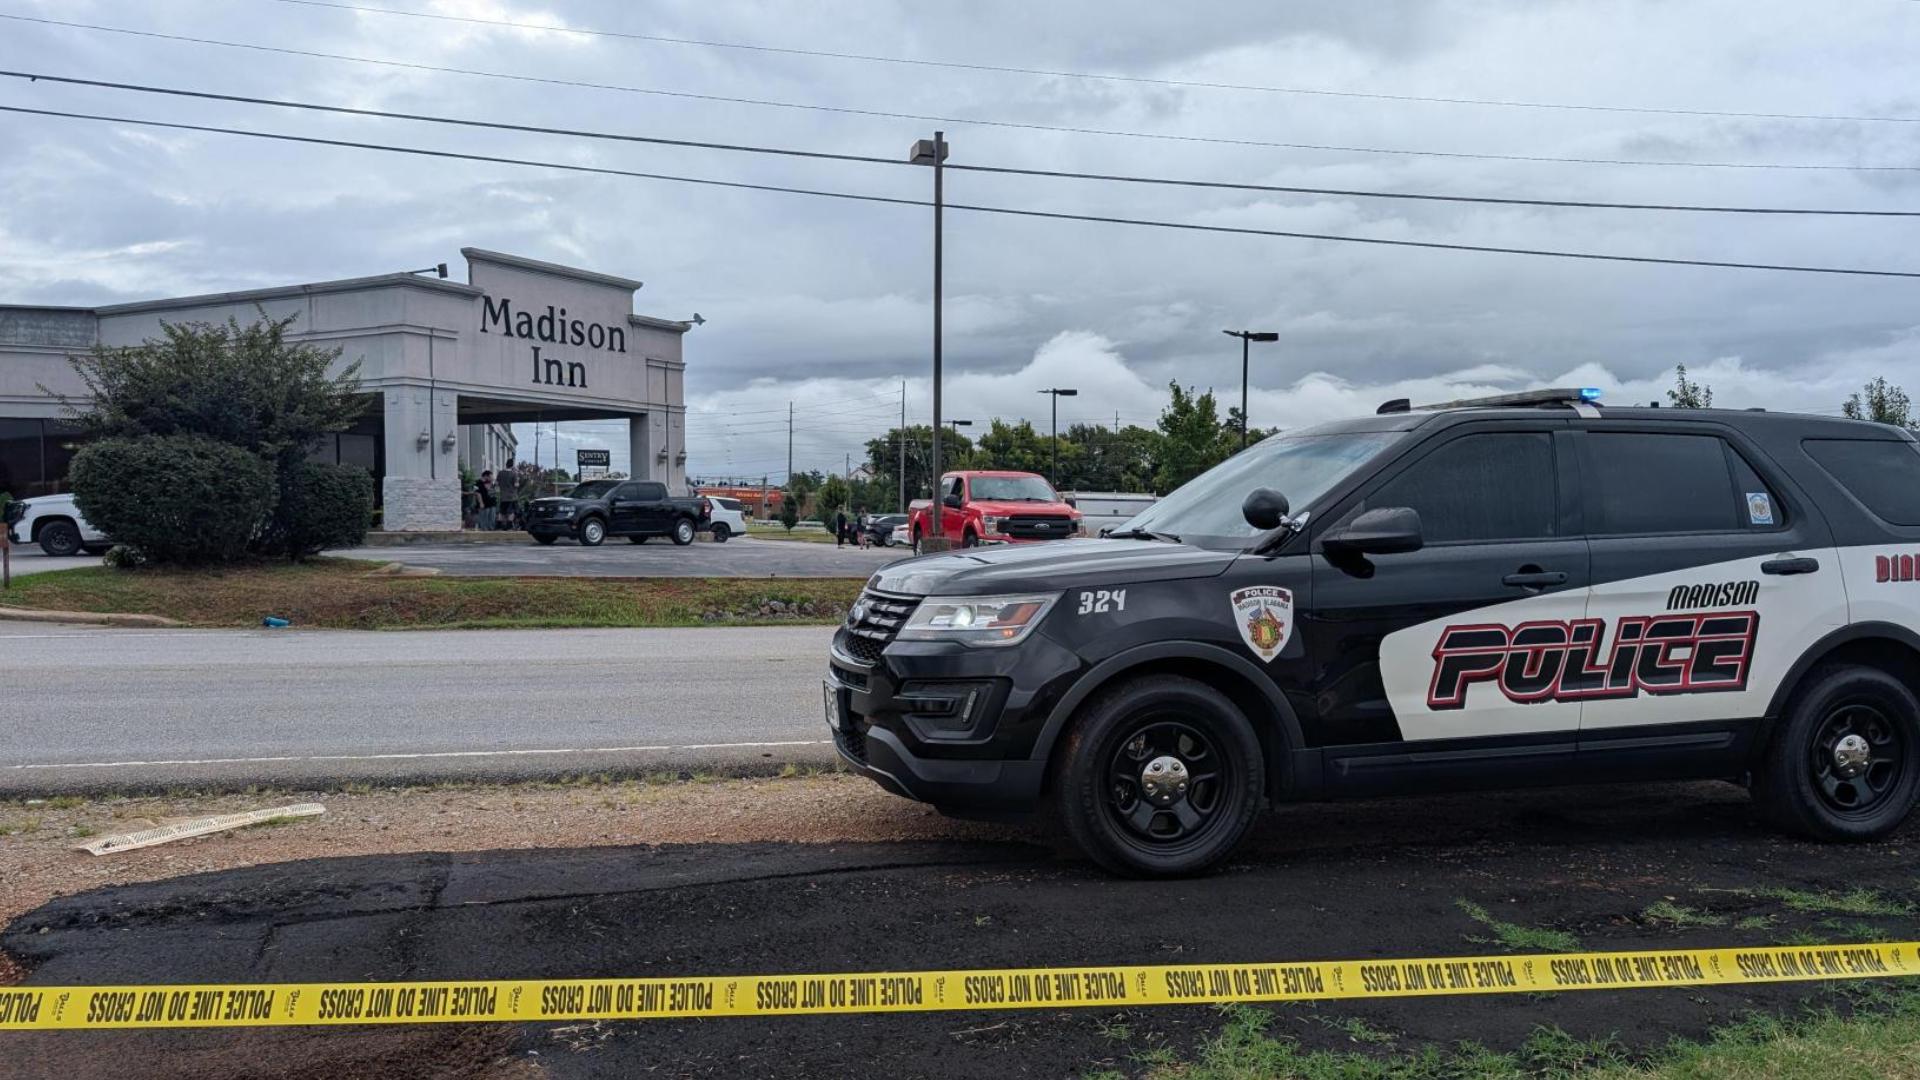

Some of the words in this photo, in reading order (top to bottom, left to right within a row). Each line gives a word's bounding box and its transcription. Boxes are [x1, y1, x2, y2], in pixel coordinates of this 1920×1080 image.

[480, 295, 627, 353] Madison
[531, 346, 588, 388] Inn
[1078, 588, 1127, 615] 324
[1244, 588, 1279, 598] POLICE
[1666, 580, 1760, 611] MADISON
[1426, 610, 1761, 711] POLICE
[1472, 961, 1517, 987] POLICE
[1550, 958, 1592, 985] CROSS
[1590, 958, 1618, 983] NOT
[1614, 957, 1637, 982] DO
[1632, 956, 1665, 981] LINE
[1659, 955, 1705, 980] POLICE
[1735, 952, 1779, 978] CROSS
[1775, 951, 1804, 977] NOT
[1798, 951, 1822, 976] DO
[1815, 950, 1849, 974] LINE
[1842, 949, 1889, 973] POLICE
[964, 975, 1005, 1004] CROSS
[1008, 975, 1032, 1003] NOT
[1034, 974, 1052, 1002] DO
[1054, 973, 1082, 1001] LINE
[1083, 972, 1126, 1000] POLICE
[1165, 970, 1206, 998] CROSS
[1208, 969, 1232, 997] NOT
[1233, 969, 1252, 996] DO
[1252, 968, 1280, 995] LINE
[1280, 966, 1324, 994] POLICE
[1360, 964, 1401, 992] CROSS
[1402, 964, 1427, 990] NOT
[1426, 963, 1446, 990] DO
[1444, 962, 1472, 989] LINE
[189, 990, 224, 1021] LINE
[224, 989, 275, 1020] POLICE
[318, 988, 365, 1019] CROSS
[365, 988, 395, 1018] NOT
[396, 988, 417, 1018] DO
[417, 987, 449, 1017] LINE
[450, 986, 498, 1016] POLICE
[541, 985, 584, 1015] CROSS
[586, 985, 613, 1014] NOT
[616, 984, 634, 1013] DO
[637, 983, 666, 1012] LINE
[669, 982, 713, 1011] POLICE
[756, 980, 798, 1010] CROSS
[801, 980, 825, 1009] NOT
[829, 979, 846, 1008] DO
[850, 978, 877, 1007] LINE
[880, 977, 923, 1006] POLICE
[0, 992, 44, 1024] POLIC
[87, 992, 136, 1023] CROSS
[135, 991, 168, 1022] NOT
[167, 991, 190, 1021] DO
